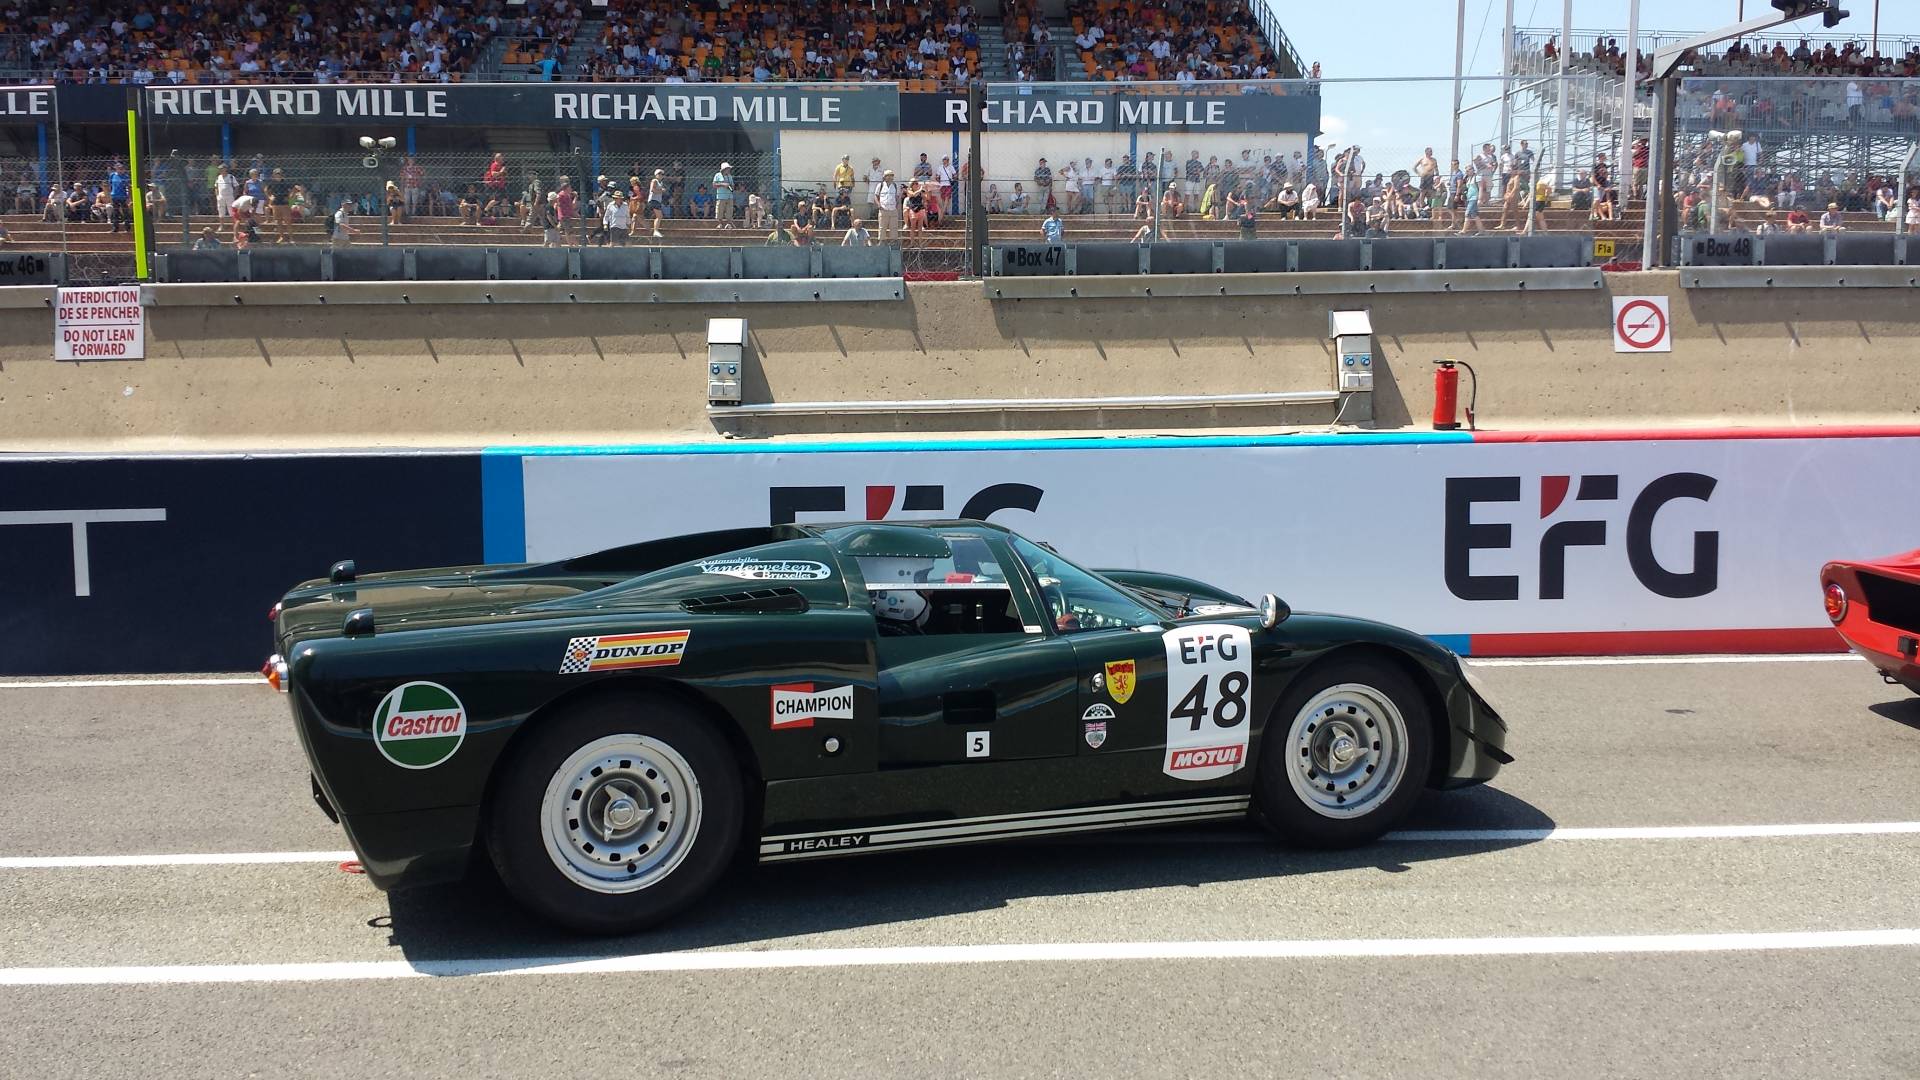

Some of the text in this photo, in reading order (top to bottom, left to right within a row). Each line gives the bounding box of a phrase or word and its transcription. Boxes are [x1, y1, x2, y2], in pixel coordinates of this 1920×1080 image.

[154, 88, 448, 118] RICHARD MILLE
[553, 92, 841, 123] RICHARD MILLE
[945, 99, 1226, 126] RCHARD MILLE
[1017, 246, 1062, 267] Box 47
[1706, 237, 1750, 257] Box 48
[17, 255, 35, 276] 46
[62, 290, 138, 304] INTERDICTION
[60, 306, 140, 320] DE SE PENCHER
[63, 328, 135, 342] DO NOT LEAN
[72, 343, 126, 356] FORWARD
[1444, 472, 1719, 600] EFG
[702, 561, 812, 574] Vanderveken
[762, 570, 812, 580] Bruxelles
[594, 643, 684, 660] DUNLOP
[1179, 633, 1238, 665] EFG
[776, 695, 852, 715] CHAMPION
[1170, 670, 1249, 731] 48
[387, 713, 462, 737] Castrol
[973, 737, 984, 753] 5
[1173, 747, 1239, 768] MOTUL
[790, 835, 864, 851] HEALEY
